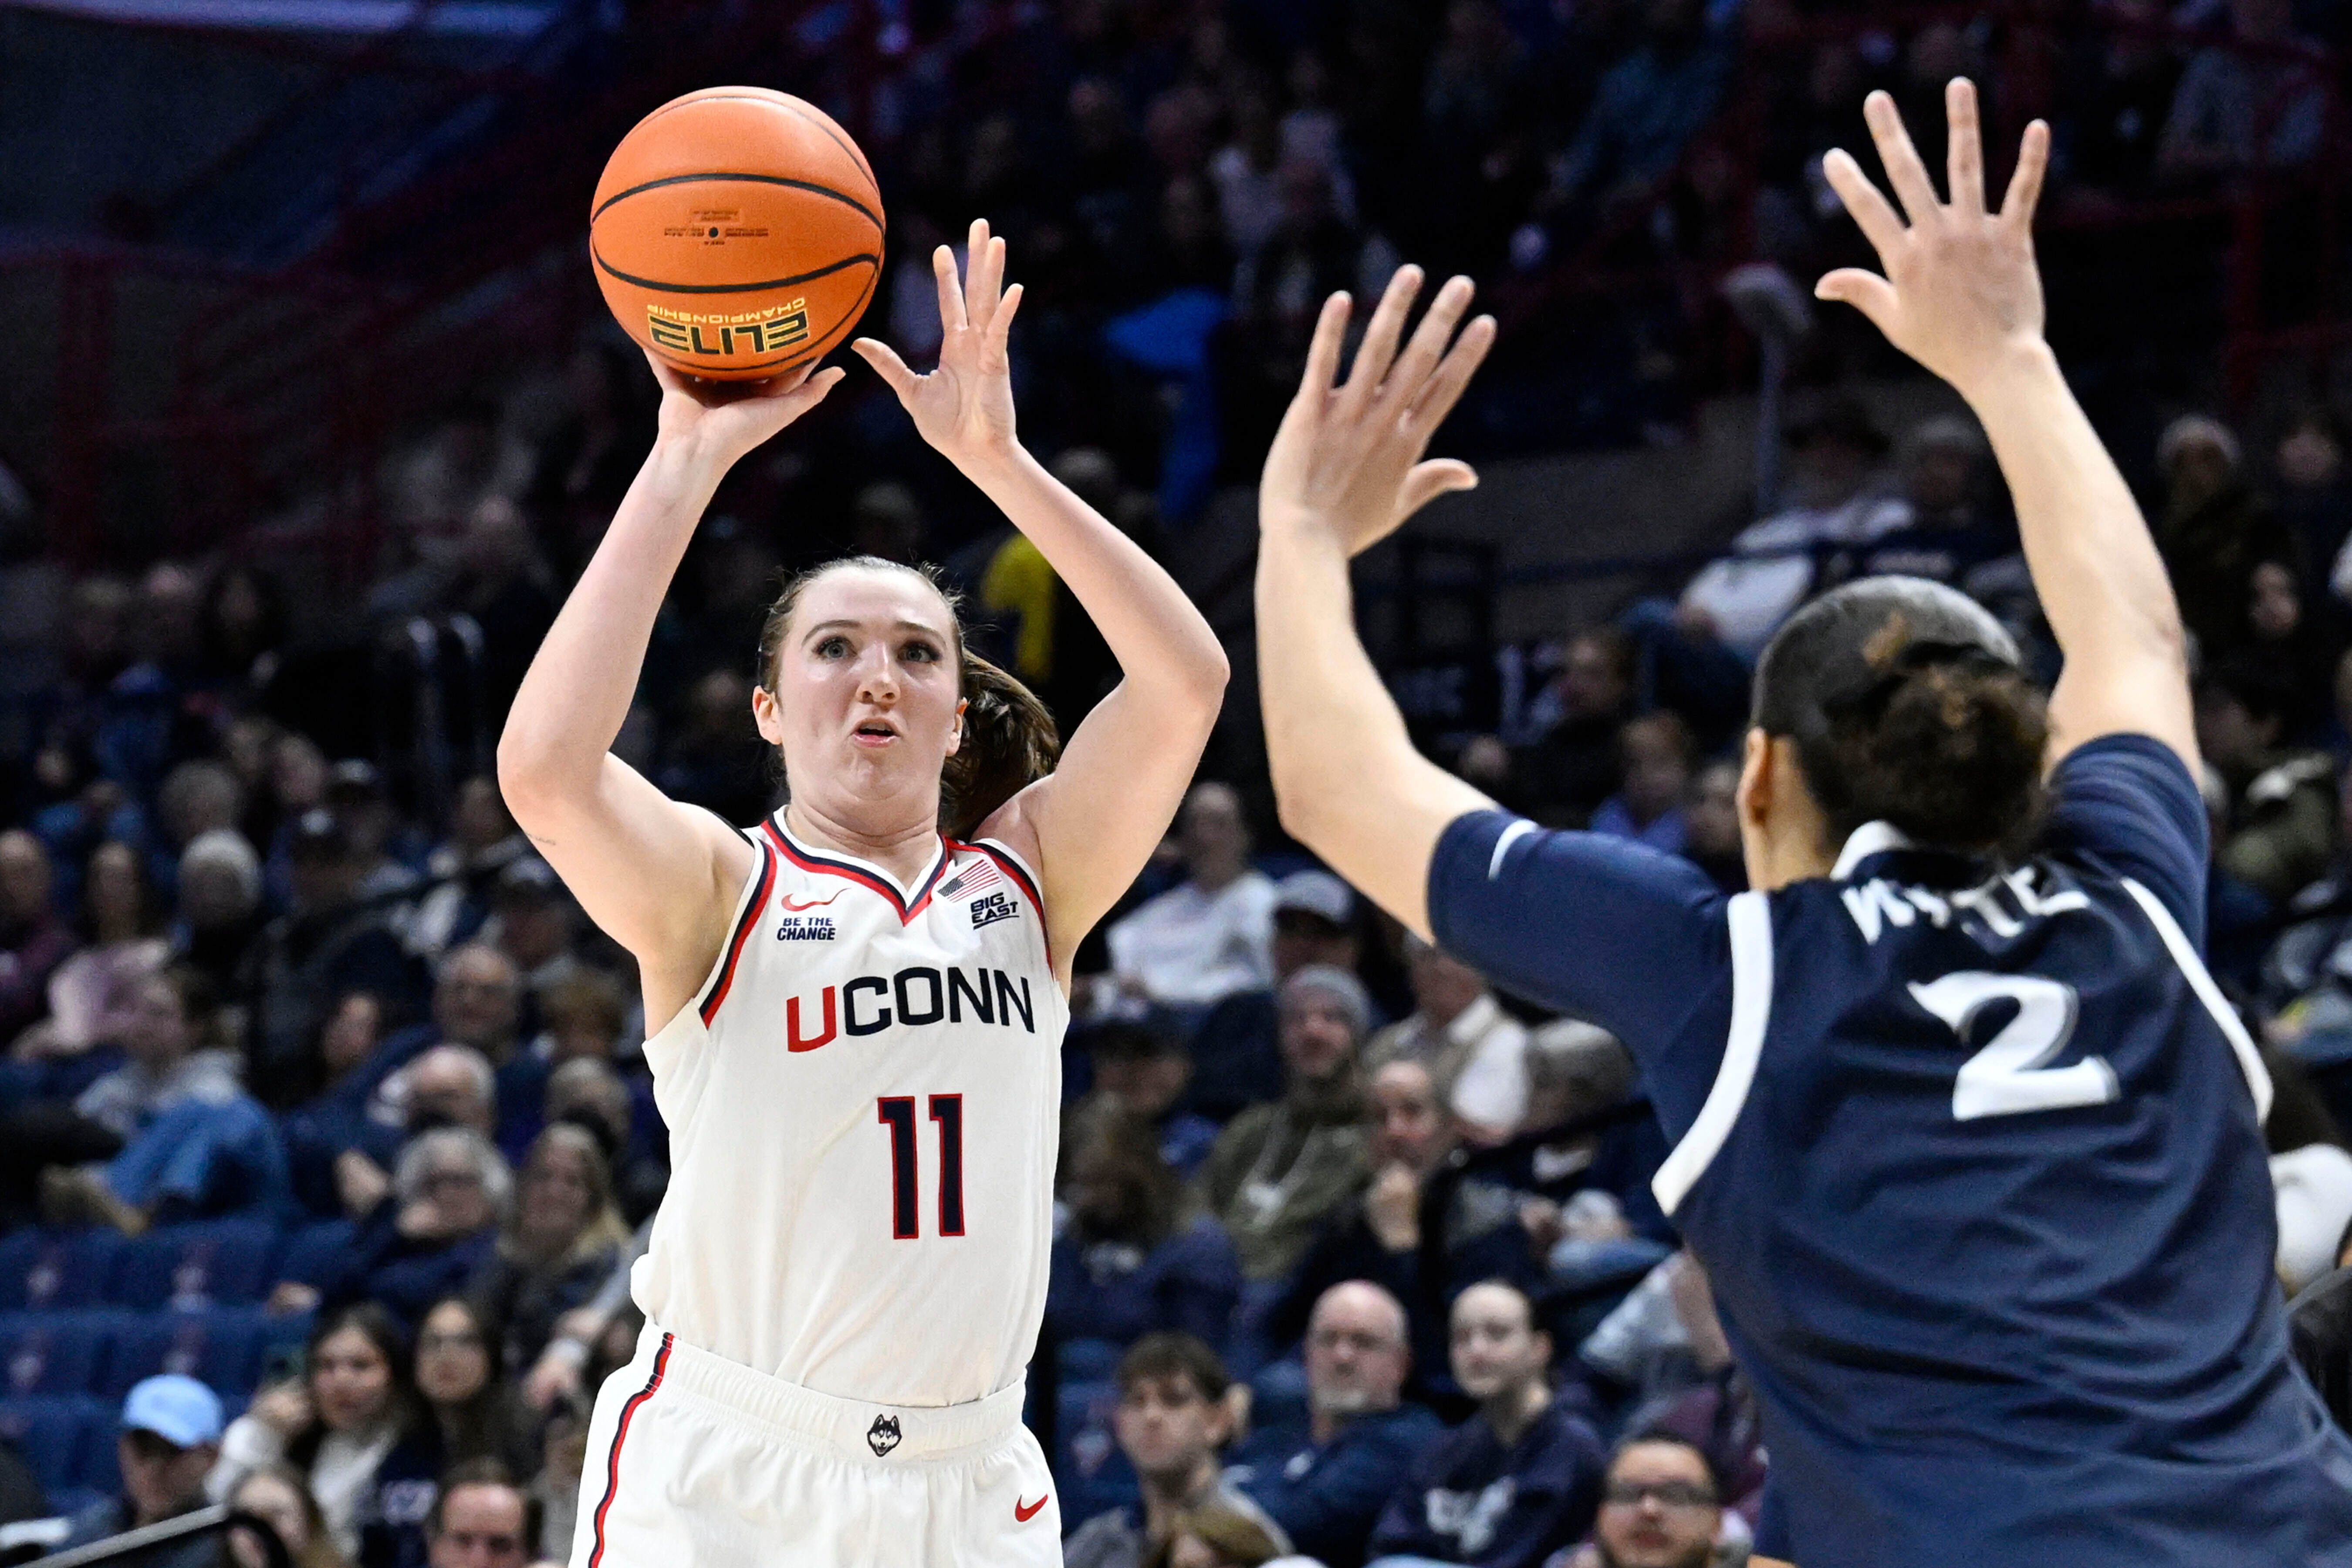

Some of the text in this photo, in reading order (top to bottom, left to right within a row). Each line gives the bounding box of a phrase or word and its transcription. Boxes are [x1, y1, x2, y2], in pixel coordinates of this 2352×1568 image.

[647, 297, 806, 324] CHAMPIONSHIP
[647, 308, 809, 355] ELITE
[970, 892, 1004, 913] BIG
[971, 901, 1018, 924] EAST
[777, 927, 836, 941] CHANGE
[783, 917, 833, 926] BE THE
[786, 966, 1035, 1053] UCONN
[1906, 970, 2121, 1122] 2
[877, 1093, 965, 1240] 11
